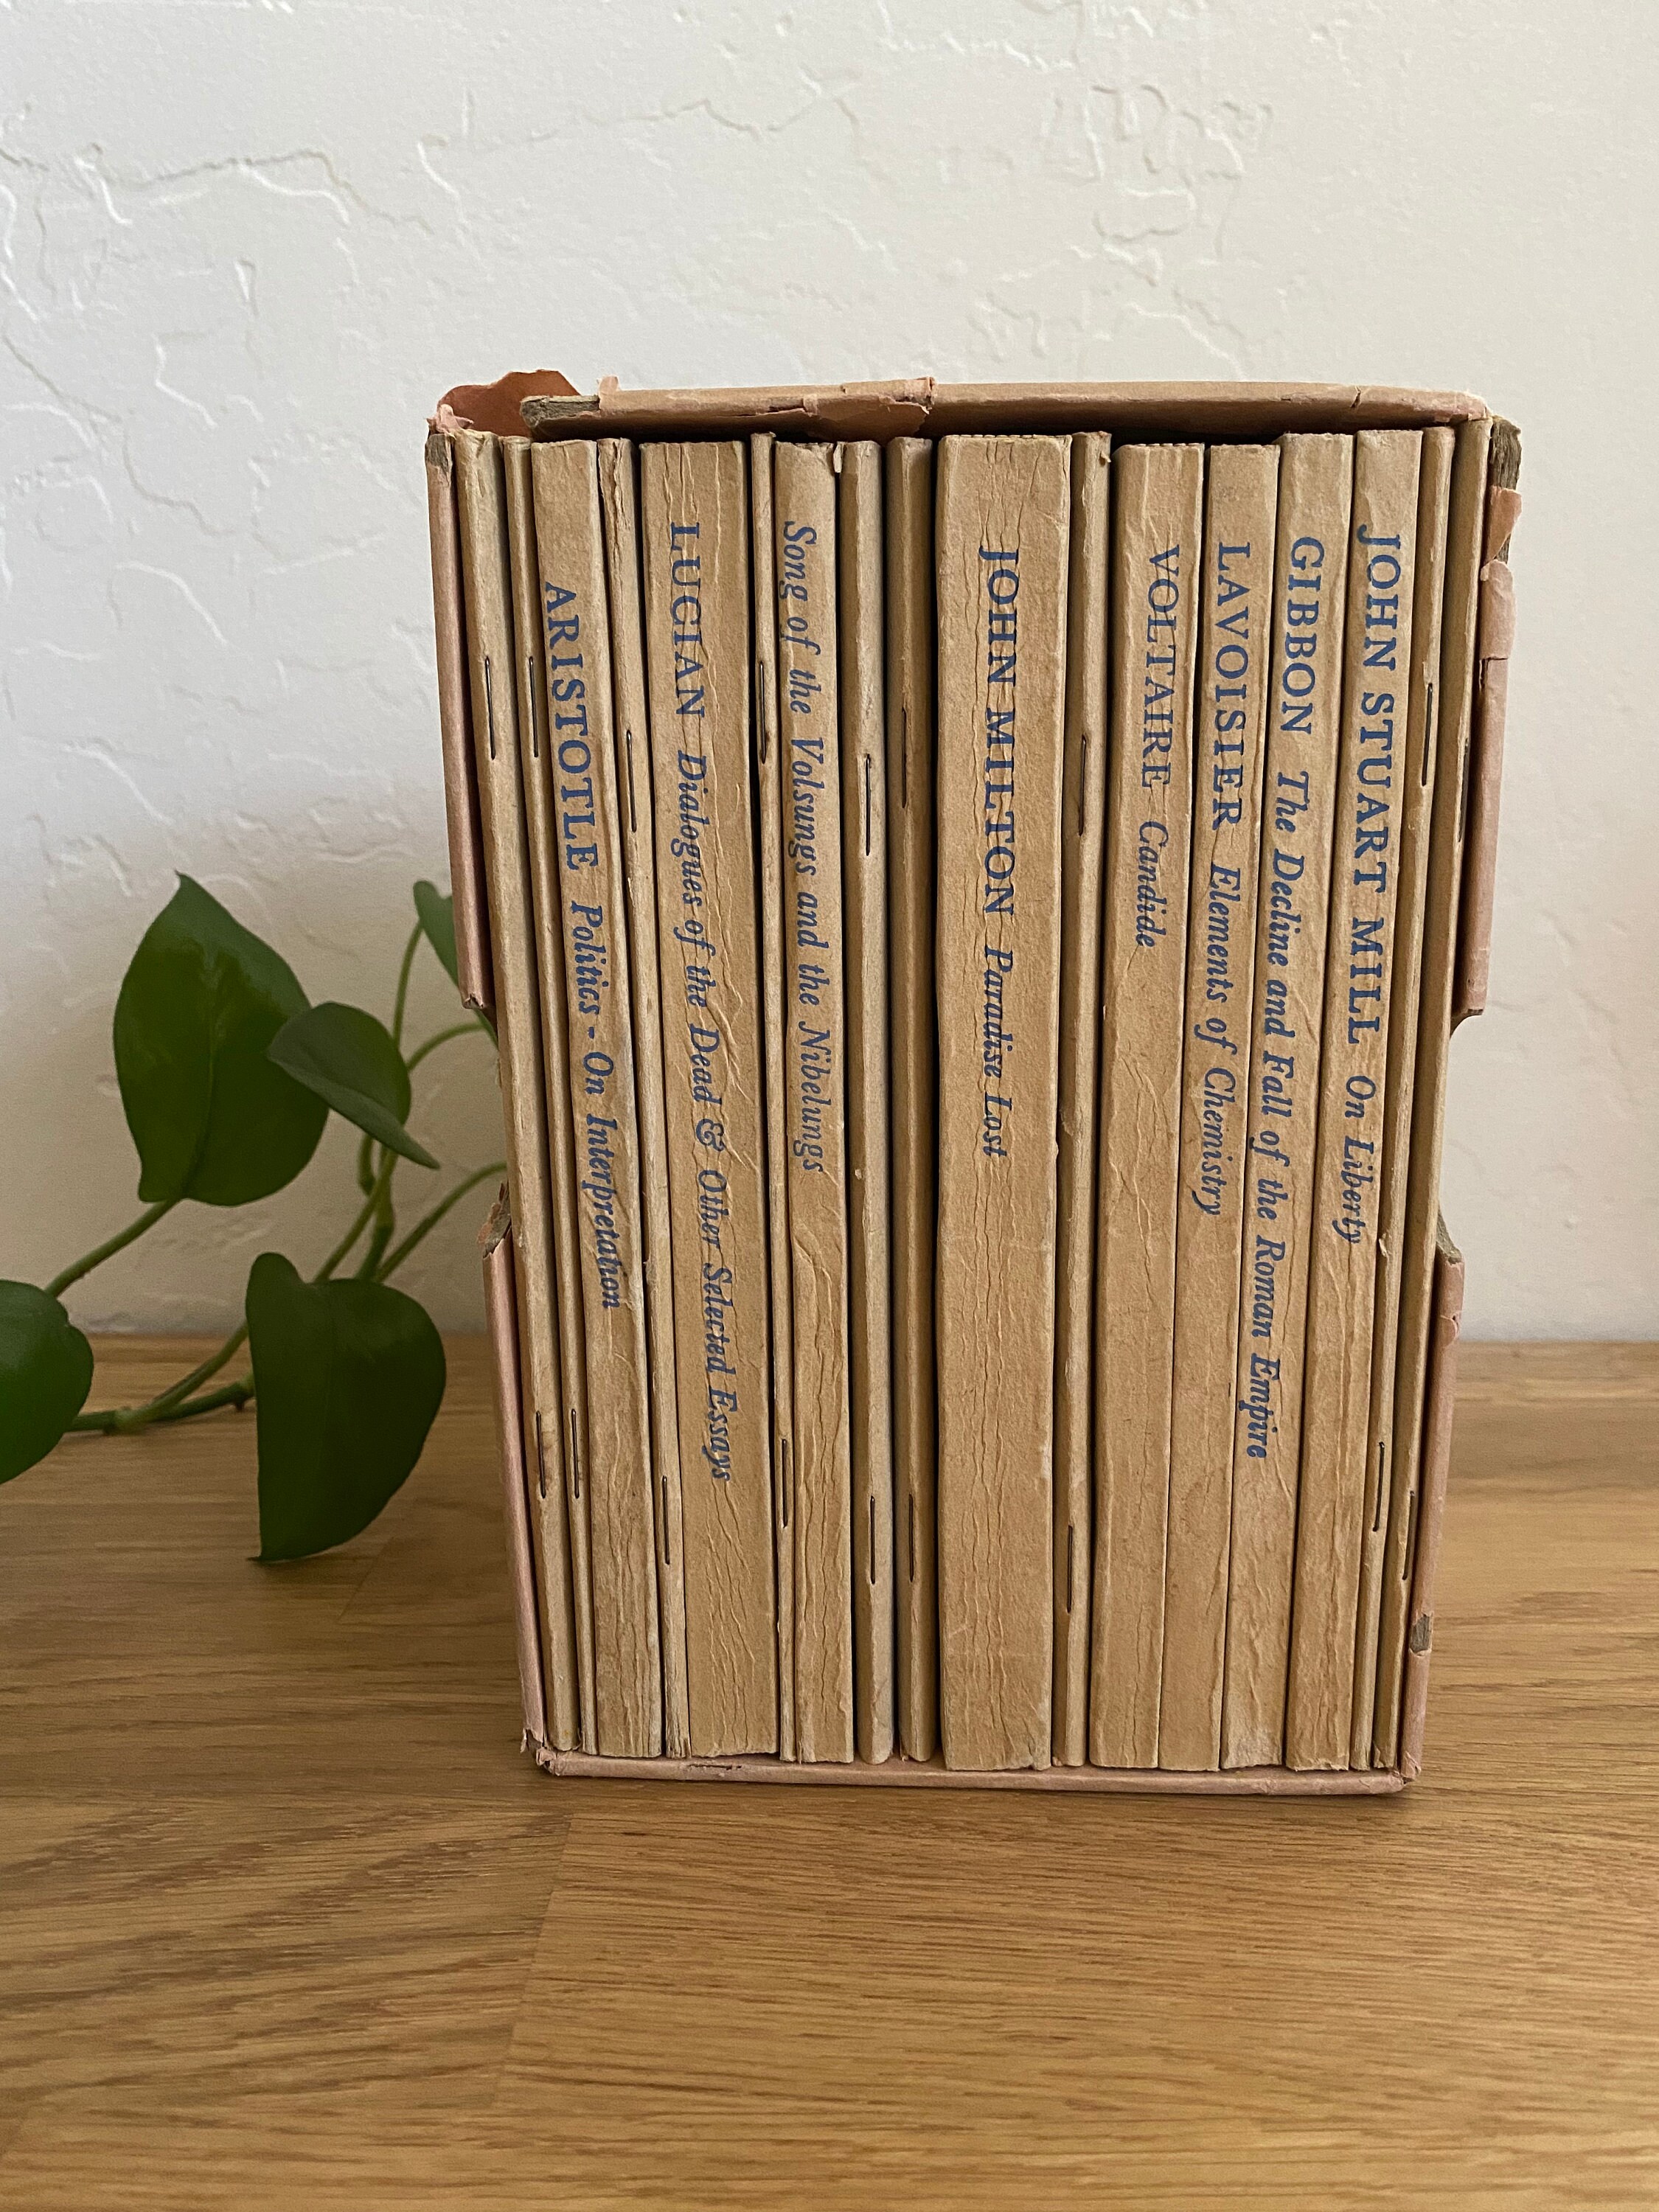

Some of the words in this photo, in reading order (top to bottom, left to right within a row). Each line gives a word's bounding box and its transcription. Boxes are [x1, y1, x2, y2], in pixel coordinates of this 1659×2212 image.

[779, 521, 817, 602] Song
[1357, 524, 1402, 672] JOHN
[670, 522, 706, 717] LUCIAN
[779, 616, 821, 655] of
[979, 545, 1019, 686] JOHN
[1142, 545, 1180, 787] VOLTAIRE
[1281, 536, 1324, 734] GIBBON
[546, 582, 599, 870] ARISTOTLE
[790, 668, 821, 714] the
[1212, 542, 1251, 830] LAVOISIER
[672, 750, 709, 906] Dialogues
[788, 737, 824, 875] Volsungs
[984, 707, 1015, 917] MILTON
[1276, 770, 1309, 832] The
[1354, 692, 1395, 894] STUART
[673, 919, 715, 956] of
[797, 891, 829, 949] and
[1136, 821, 1169, 947] Candide
[1206, 862, 1241, 1003] Elements
[1267, 848, 1304, 967] Decline
[571, 900, 608, 1015] Politics
[686, 965, 716, 1007] the
[799, 964, 830, 1006] the
[984, 945, 1013, 1077] Paradise
[1264, 980, 1295, 1038] and
[1348, 917, 1384, 1043] MILL
[583, 1051, 615, 1094] On
[689, 1023, 722, 1105] Dead
[1194, 1018, 1237, 1055] of
[1261, 1050, 1294, 1119] Fall
[695, 1119, 725, 1151] &
[793, 1021, 831, 1172] Nibelungs
[982, 1092, 1012, 1157] Lost
[1192, 1067, 1235, 1217] Chemistry
[1249, 1130, 1290, 1167] of
[1344, 1075, 1375, 1118] On
[582, 1113, 622, 1308] Interpretation
[698, 1169, 728, 1248] Other
[1257, 1179, 1287, 1220] the
[1332, 1135, 1374, 1244] Liberty
[703, 1262, 736, 1375] Selected
[1252, 1235, 1285, 1338] Roman
[703, 1386, 737, 1481] Essays
[1238, 1352, 1281, 1458] Empire
